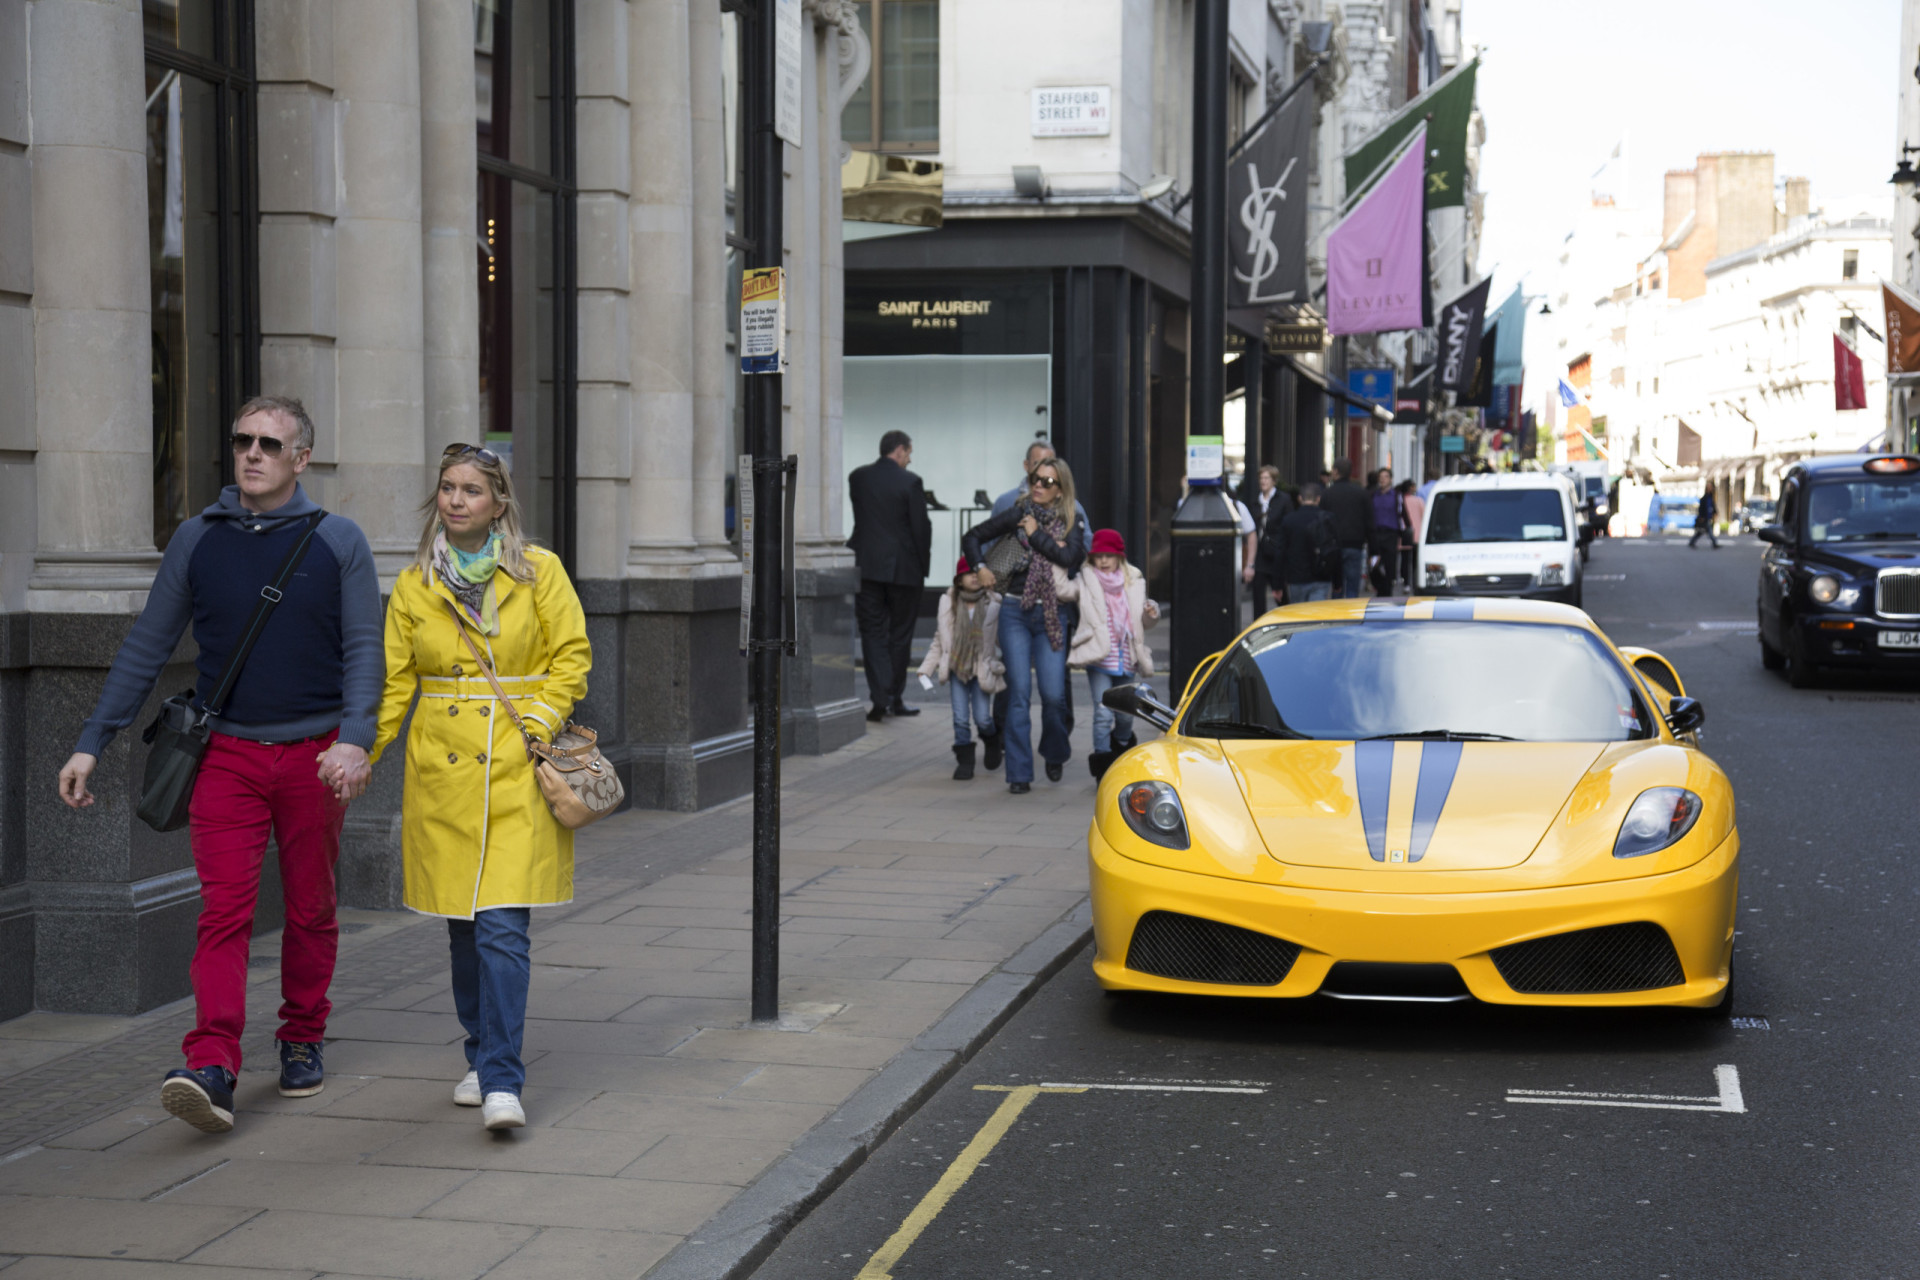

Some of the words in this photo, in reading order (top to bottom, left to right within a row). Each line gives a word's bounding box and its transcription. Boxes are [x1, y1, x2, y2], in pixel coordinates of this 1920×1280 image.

[1039, 91, 1099, 105] STAFFORD
[1039, 106, 1081, 120] STREET
[1089, 106, 1106, 119] W1
[878, 301, 921, 316] SAINT
[922, 300, 991, 316] LAURENT
[1341, 293, 1407, 310] LEVIEV
[912, 318, 958, 329] PARIS
[1443, 304, 1469, 384] DKNY
